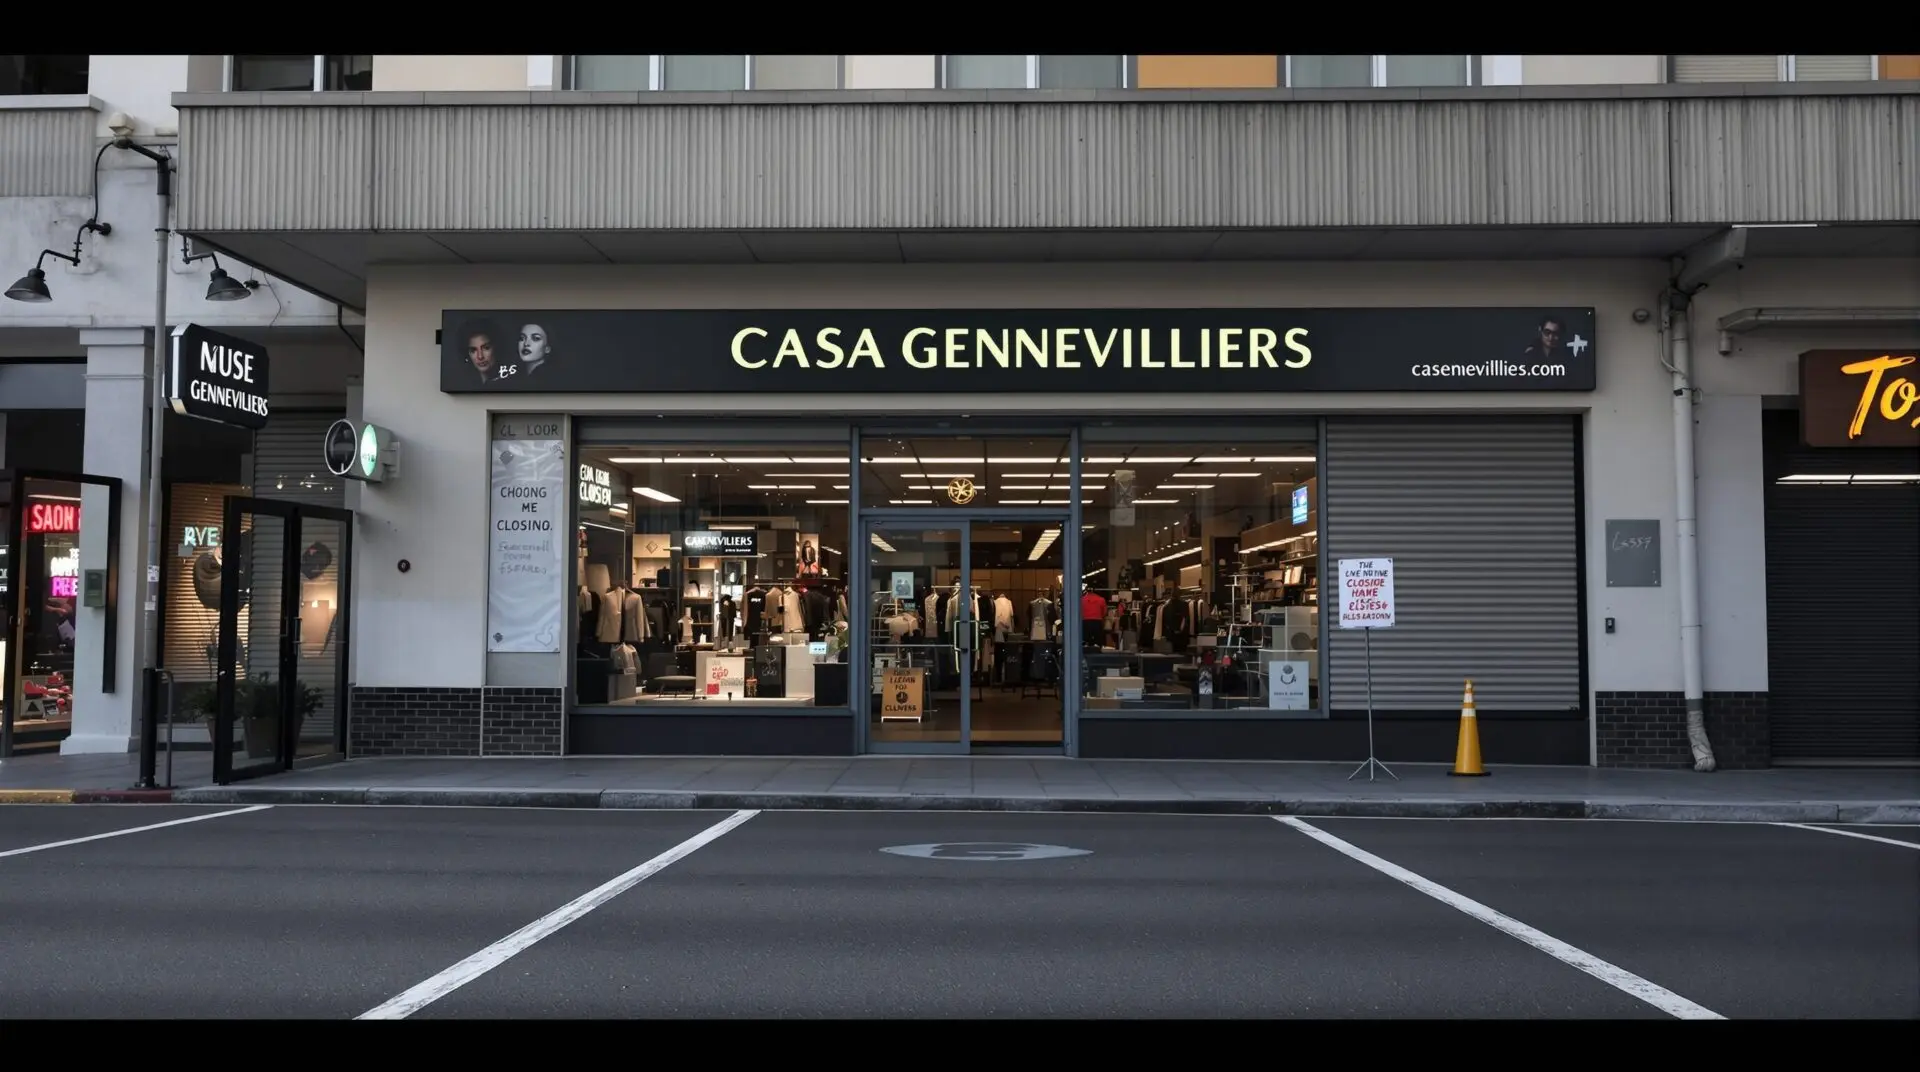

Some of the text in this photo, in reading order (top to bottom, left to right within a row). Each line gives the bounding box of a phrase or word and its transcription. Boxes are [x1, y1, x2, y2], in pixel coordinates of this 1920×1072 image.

[731, 327, 1312, 369] CASA GENNEVILLIERS
[521, 502, 538, 513] ME
